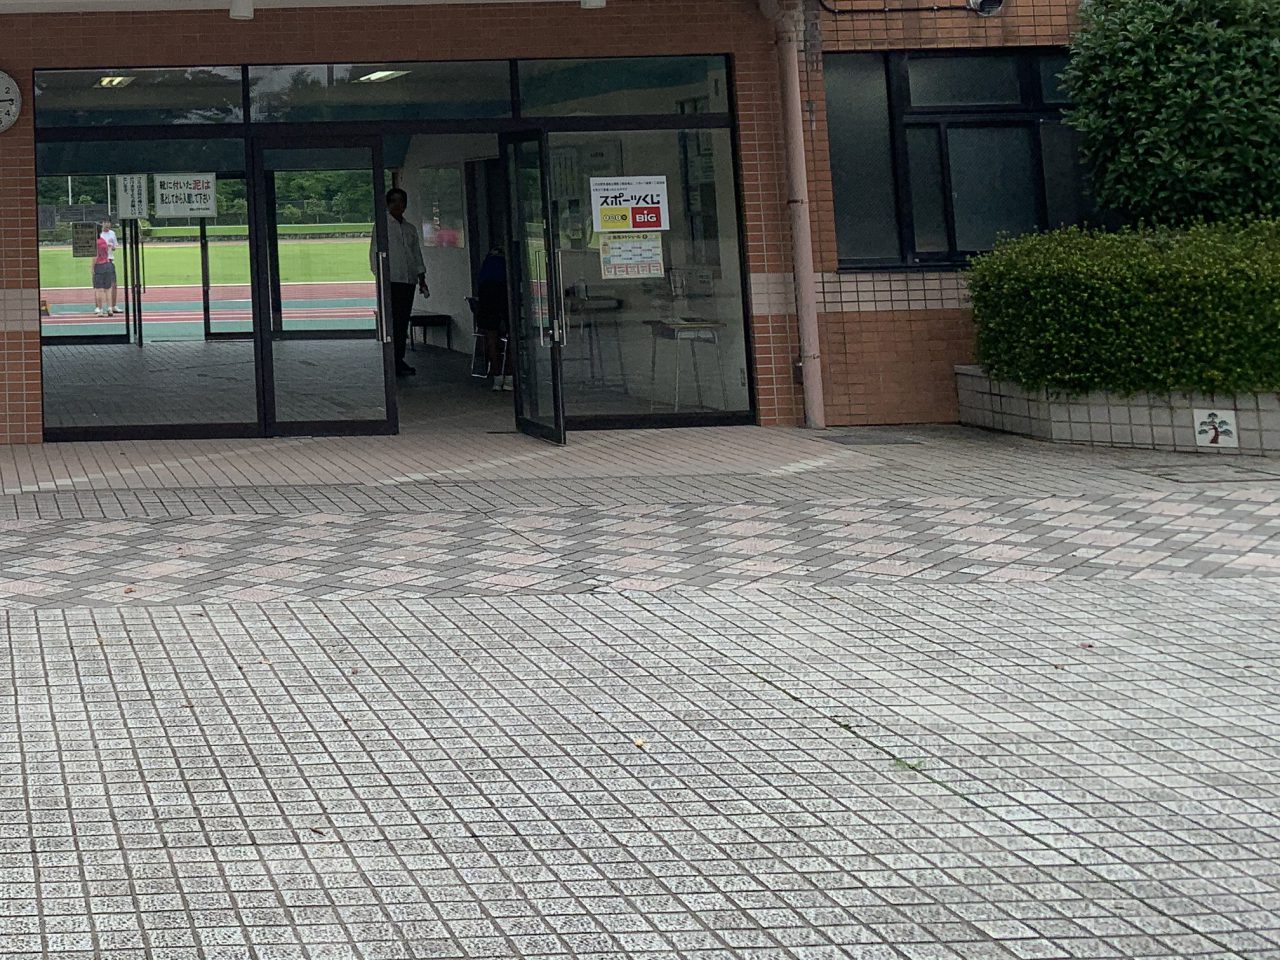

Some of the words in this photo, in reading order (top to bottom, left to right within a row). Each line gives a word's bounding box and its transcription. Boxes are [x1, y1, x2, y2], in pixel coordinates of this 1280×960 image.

[5, 109, 11, 117] 4
[160, 179, 210, 190] 靴に付いた泥は
[599, 193, 660, 206] スポーツくじ
